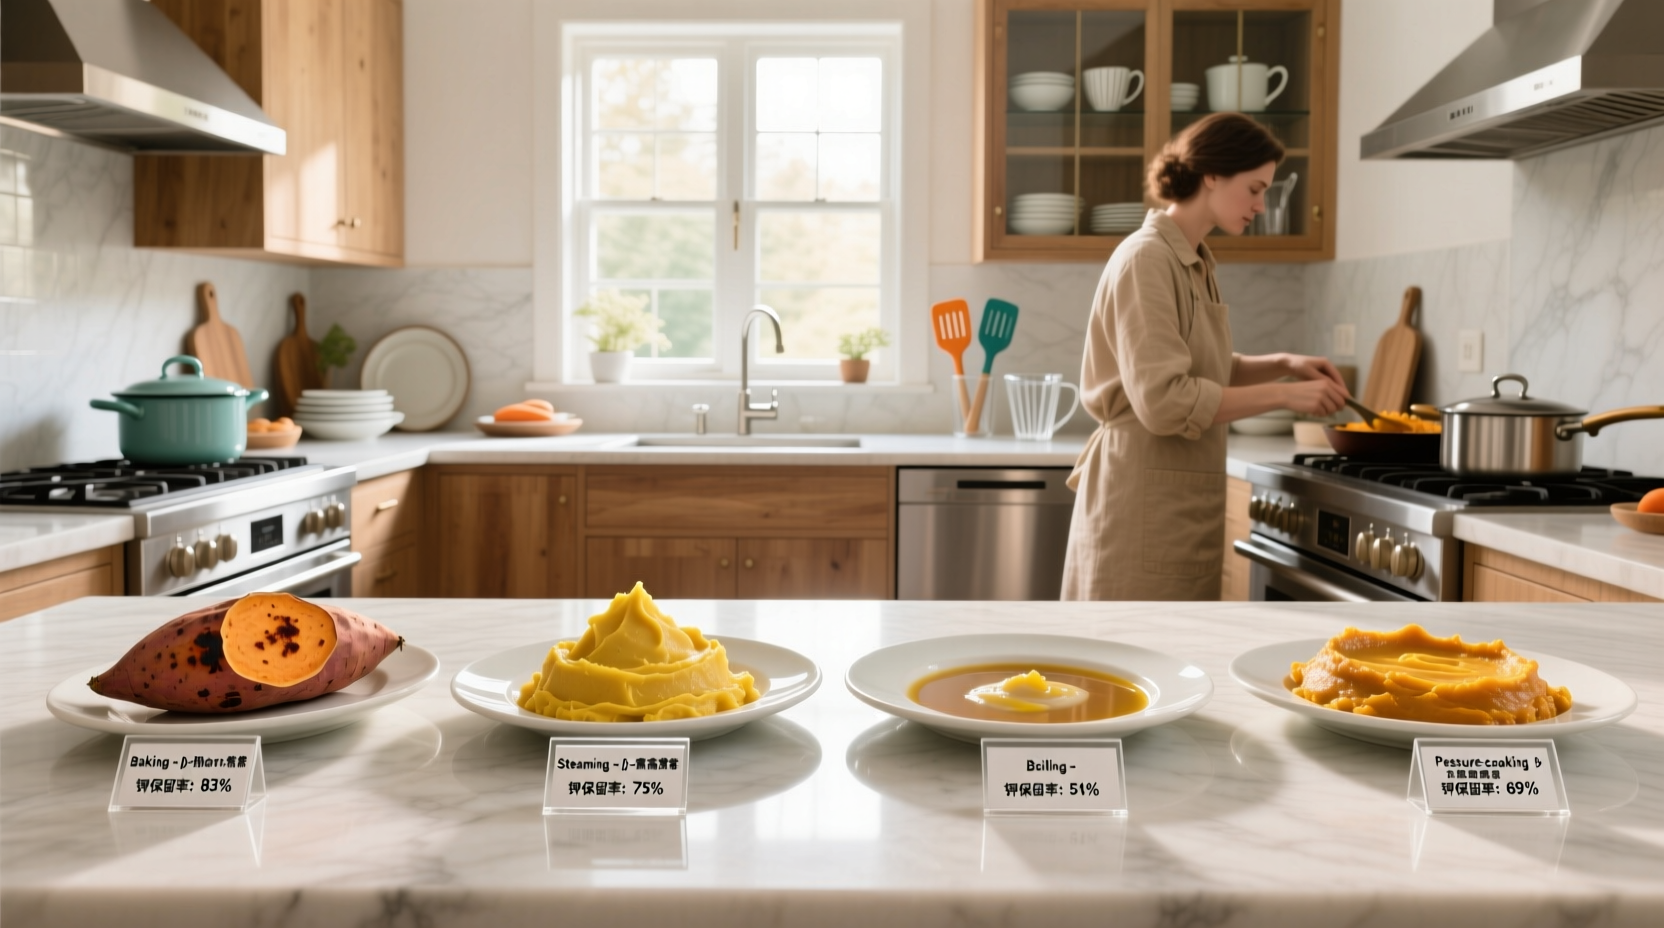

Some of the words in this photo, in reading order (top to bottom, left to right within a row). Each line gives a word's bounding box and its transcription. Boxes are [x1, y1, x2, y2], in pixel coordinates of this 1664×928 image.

[130, 755, 169, 770] Baking
[557, 757, 609, 772] Steaming
[200, 778, 232, 793] 83%
[632, 781, 664, 795] 75%
[1069, 782, 1099, 796] 51%
[1506, 781, 1539, 795] 69%
